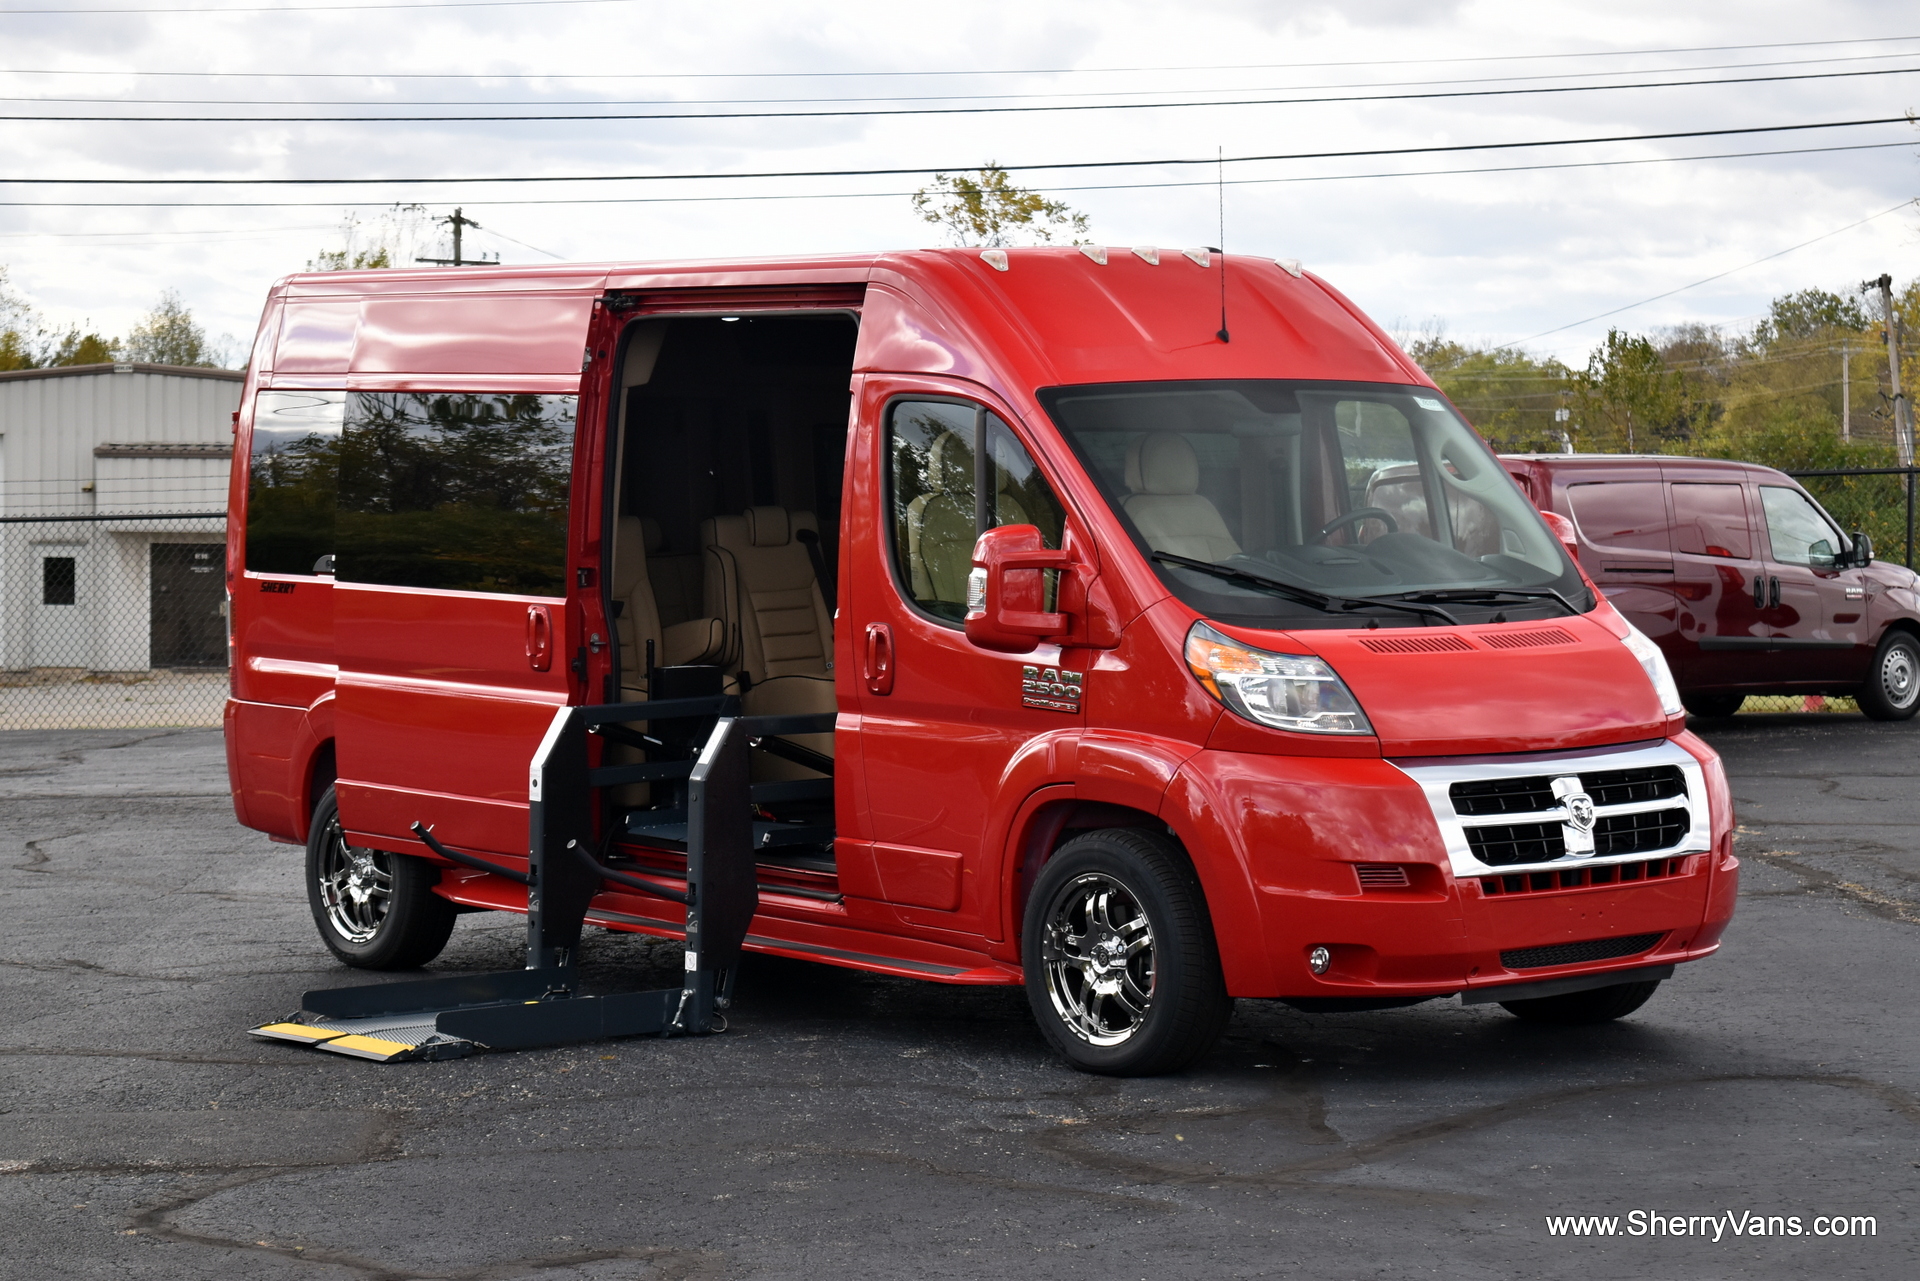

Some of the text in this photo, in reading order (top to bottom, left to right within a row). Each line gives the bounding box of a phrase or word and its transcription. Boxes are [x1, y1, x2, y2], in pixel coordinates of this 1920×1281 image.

[260, 581, 296, 594] SHERRY
[1023, 665, 1083, 685] RAM
[1022, 679, 1082, 699] 2500
